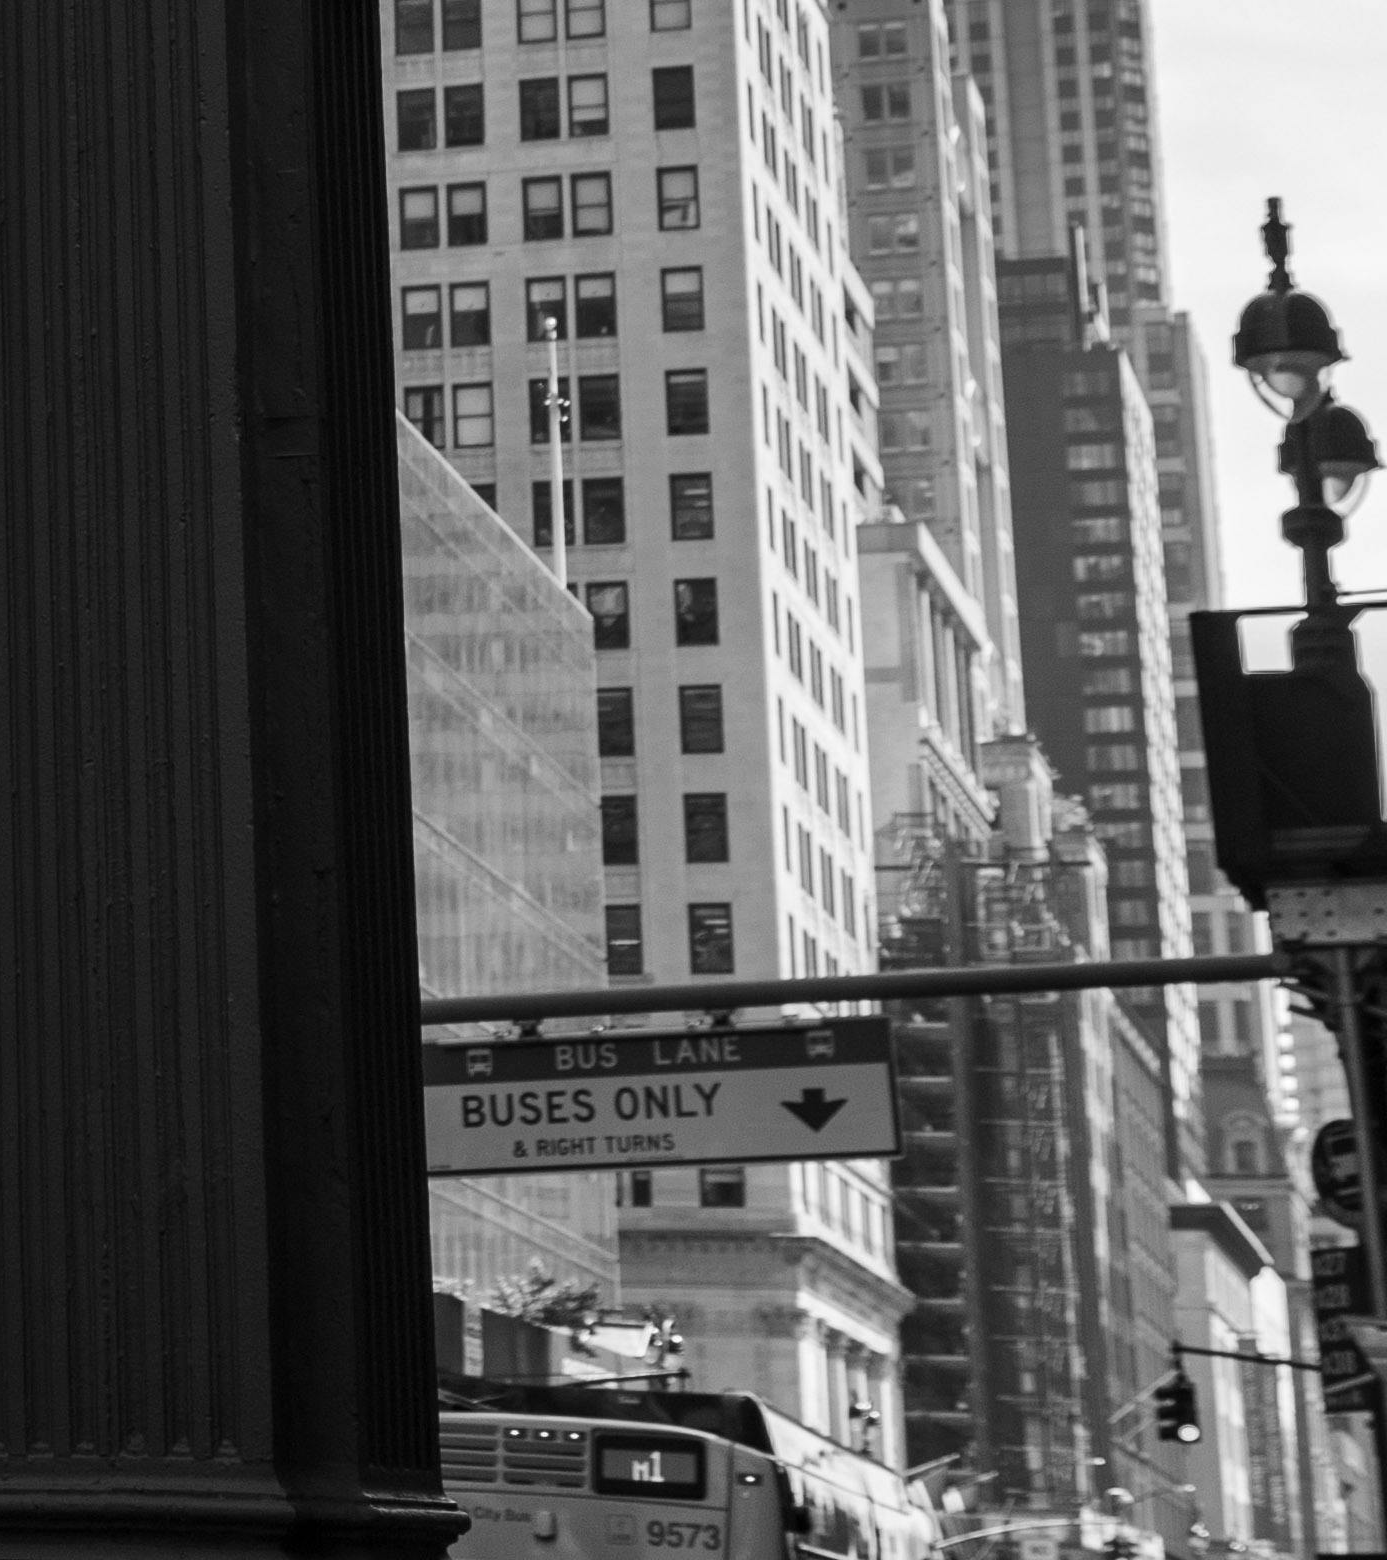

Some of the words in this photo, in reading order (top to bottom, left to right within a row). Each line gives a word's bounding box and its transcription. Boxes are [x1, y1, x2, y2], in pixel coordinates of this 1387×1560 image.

[554, 1043, 619, 1072] BUS
[652, 1035, 742, 1066] LANE
[460, 1089, 596, 1129] BUSES
[613, 1082, 723, 1122] ONLY
[512, 1141, 529, 1159] &
[536, 1136, 598, 1157] RIGHT
[604, 1133, 676, 1155] TURNS
[647, 1520, 722, 1551] 9573
